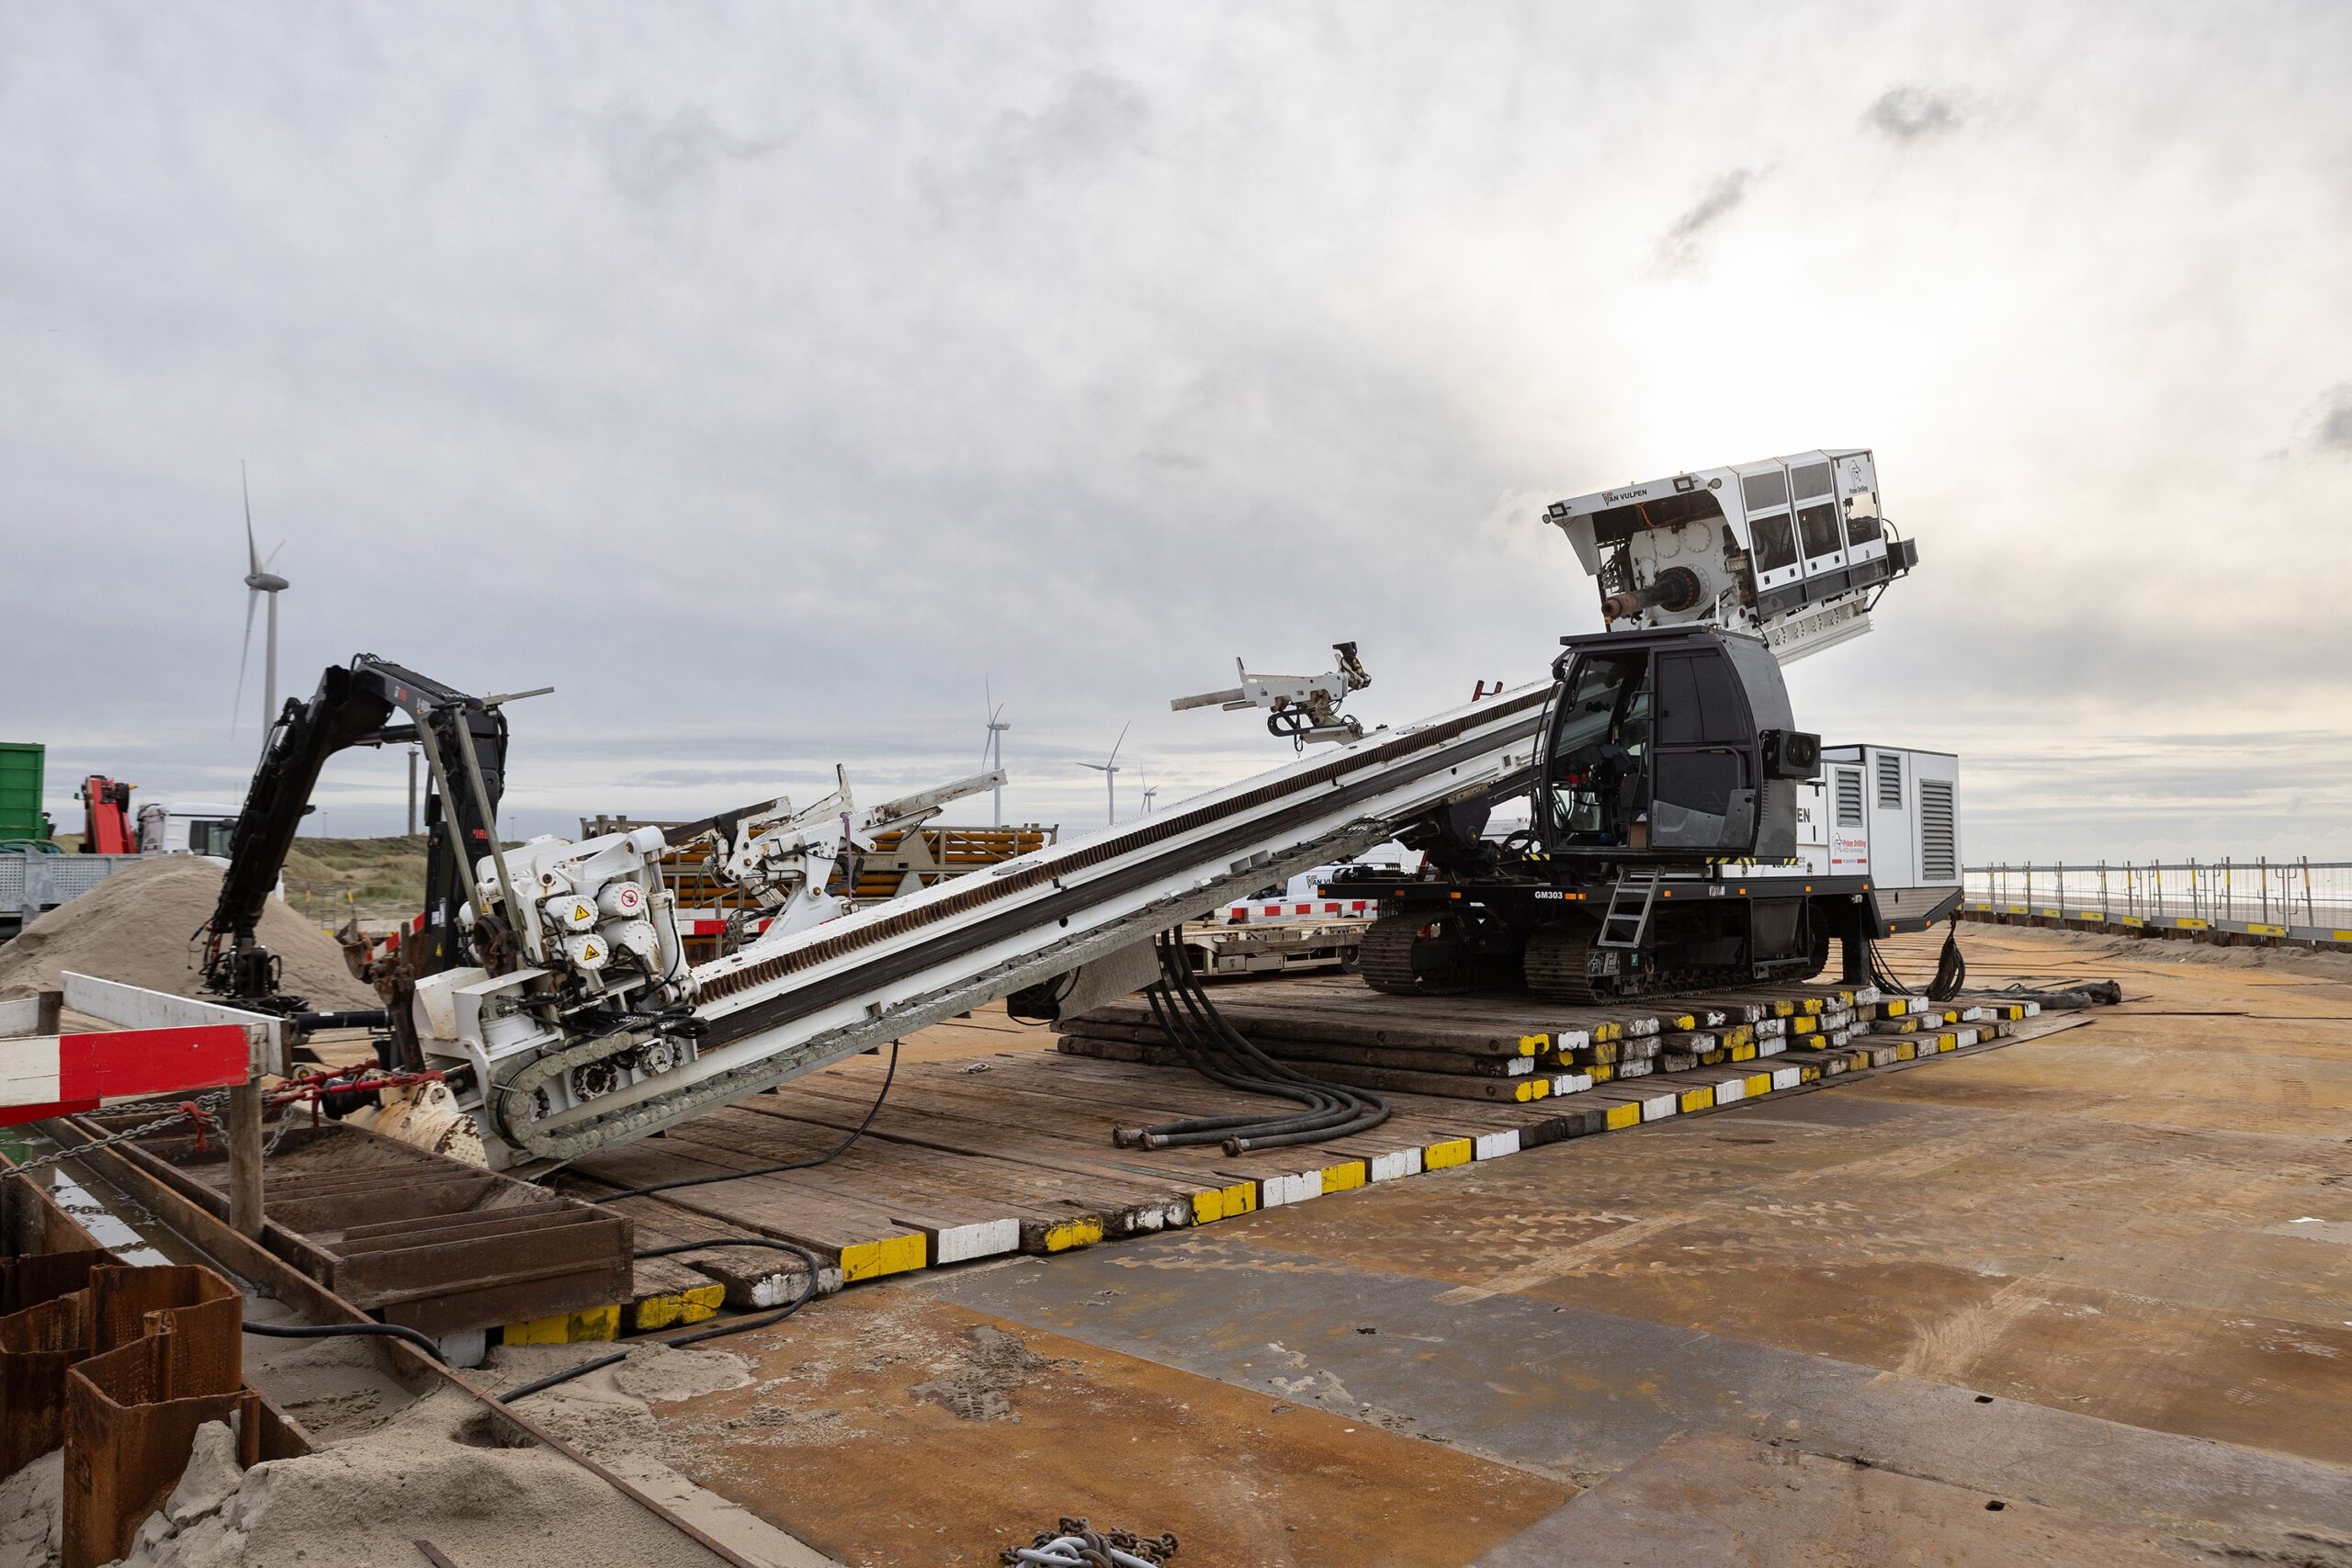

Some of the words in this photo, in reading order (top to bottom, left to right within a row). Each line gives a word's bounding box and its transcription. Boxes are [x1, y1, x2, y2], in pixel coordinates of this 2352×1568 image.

[1601, 491, 1619, 507] VAN
[1620, 489, 1647, 500] VULPEN
[1854, 840, 1866, 849] Drilling
[1306, 874, 1322, 889] VAN
[1534, 891, 1563, 899] GM303
